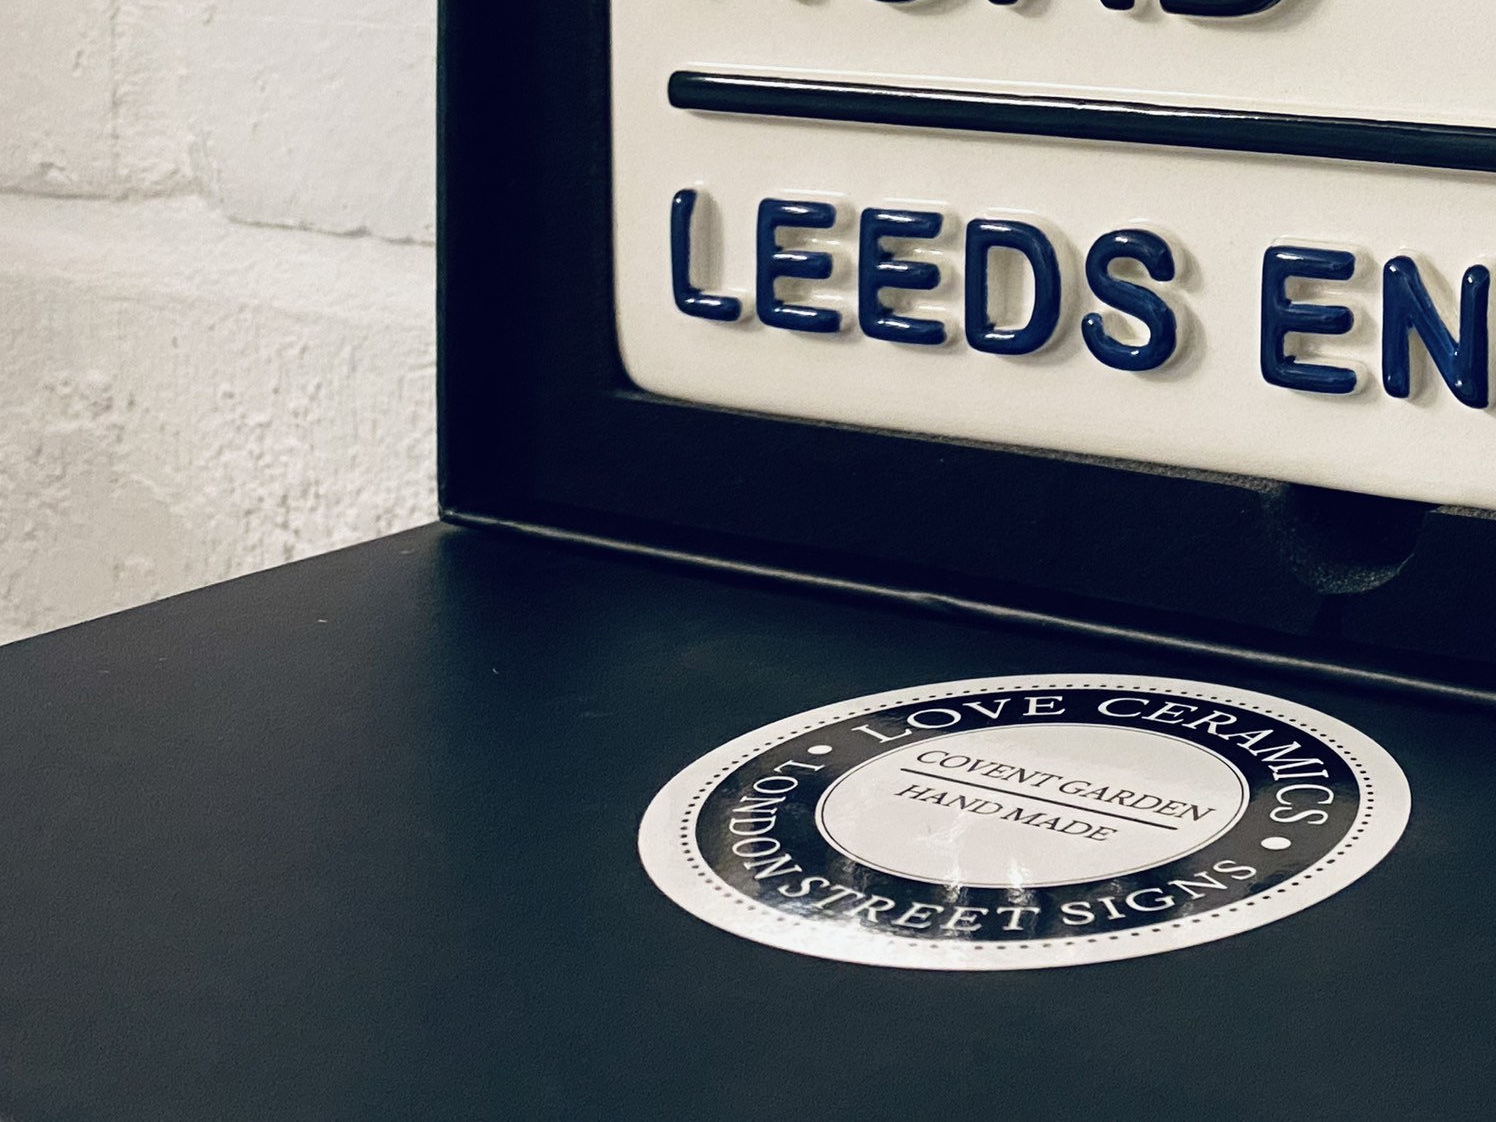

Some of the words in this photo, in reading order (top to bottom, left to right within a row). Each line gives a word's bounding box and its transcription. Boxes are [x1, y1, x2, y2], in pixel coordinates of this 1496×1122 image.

[670, 188, 1177, 372] LEEDS
[852, 695, 1065, 744] LOVE
[1097, 697, 1335, 828] CERAMICS
[894, 784, 1004, 815] HAND
[1000, 807, 1118, 842] MADE
[916, 749, 1063, 788] COVENT
[1058, 777, 1216, 823] GARDEN
[729, 758, 825, 880] LONDON
[777, 875, 1042, 932] STREET
[1061, 859, 1257, 926] SIGNS
